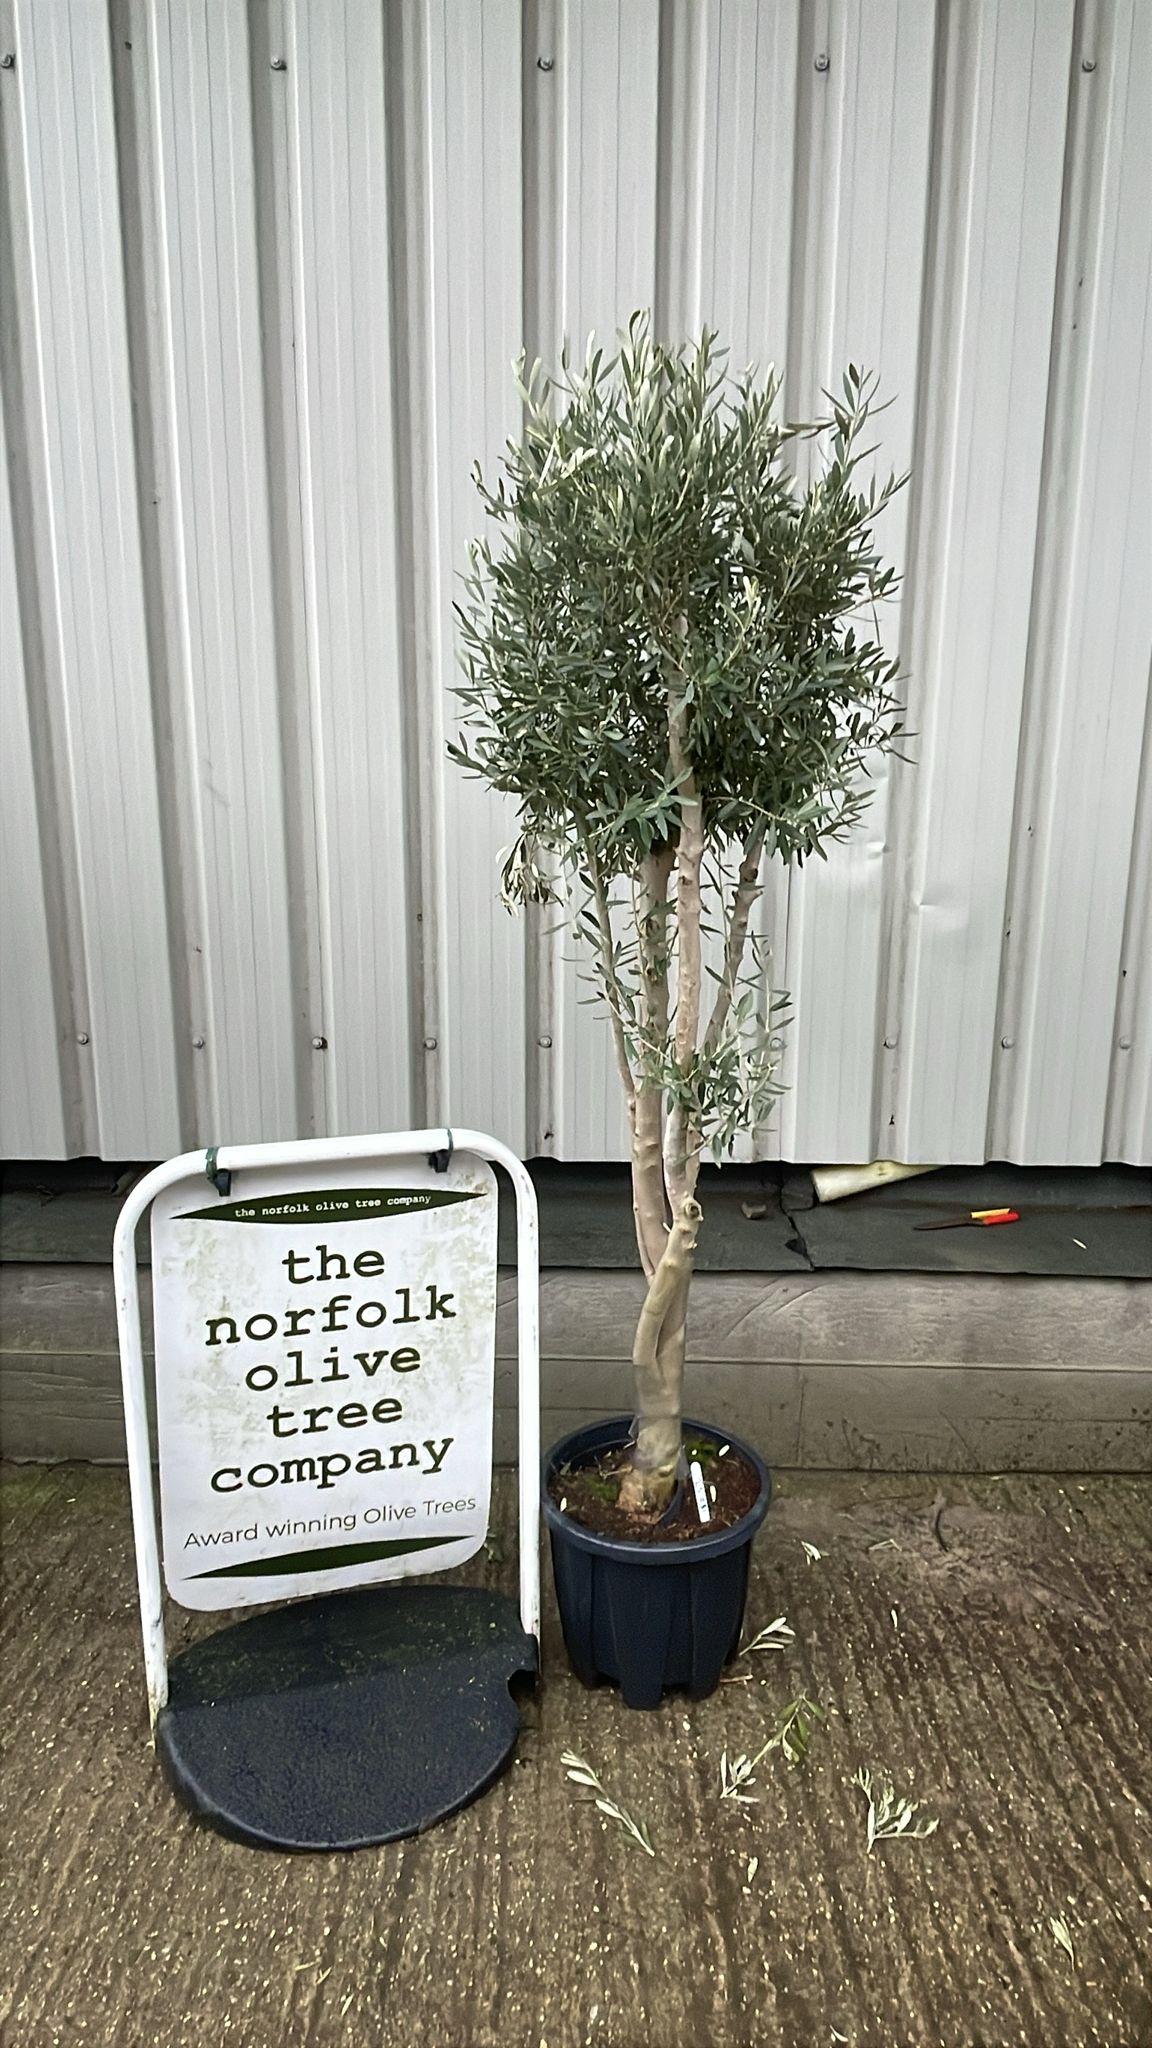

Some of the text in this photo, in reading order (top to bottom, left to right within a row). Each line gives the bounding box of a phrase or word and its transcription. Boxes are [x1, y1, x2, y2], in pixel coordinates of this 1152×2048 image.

[235, 1194, 432, 1217] the norfolk olive tree company
[282, 1245, 385, 1284] the
[205, 1285, 456, 1346] norfolk
[245, 1346, 421, 1391] olive
[267, 1397, 403, 1438] tree
[211, 1437, 454, 1493] company
[183, 1495, 477, 1550] Award winning Olive Trees
